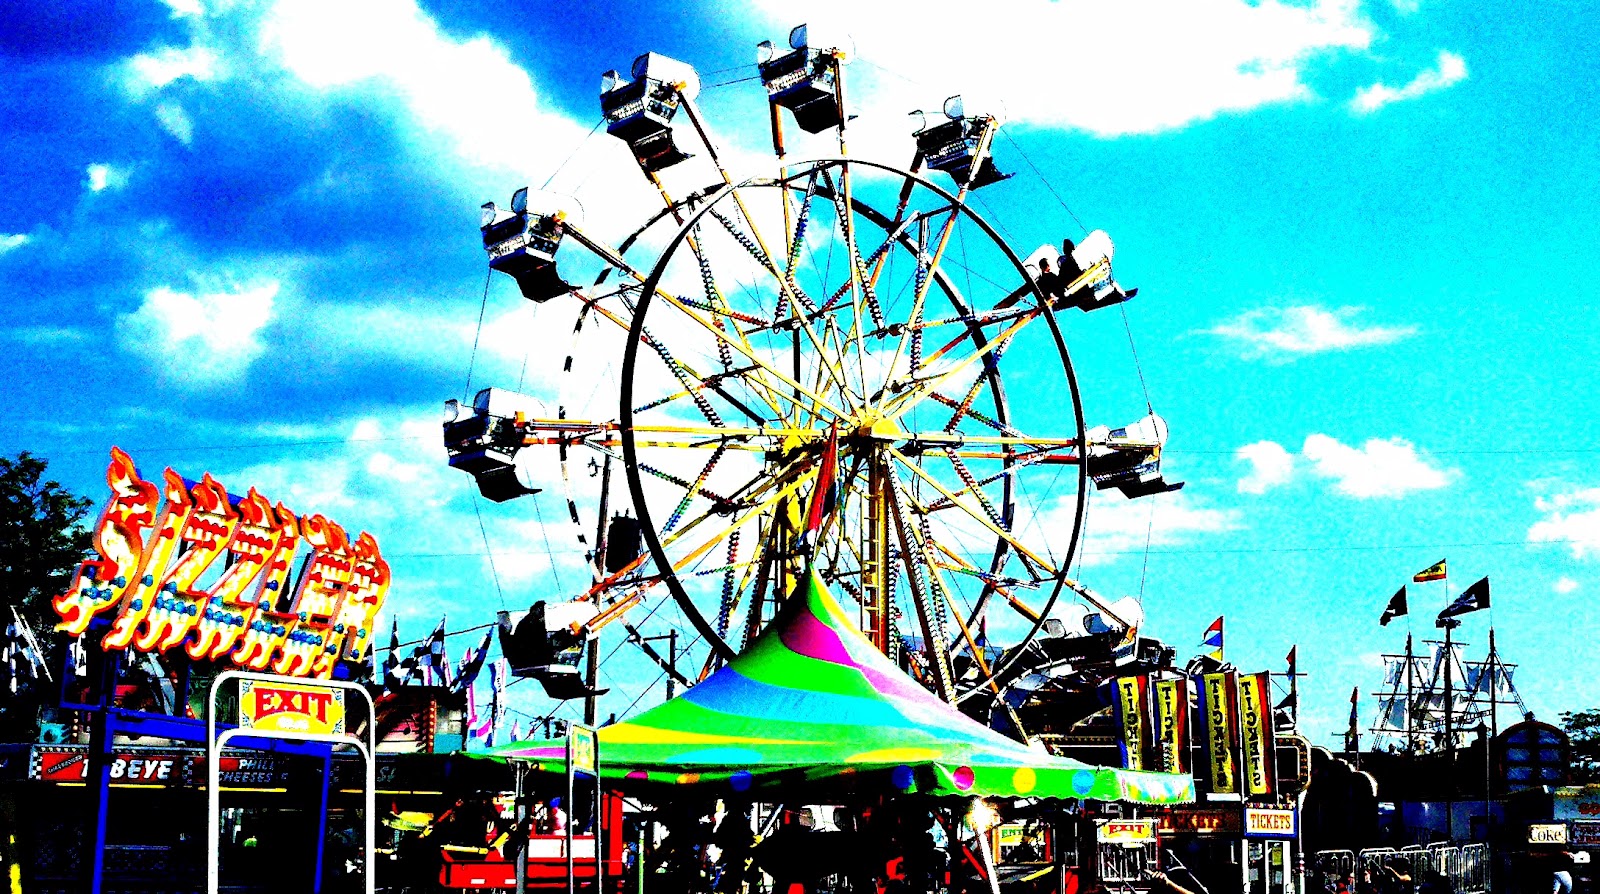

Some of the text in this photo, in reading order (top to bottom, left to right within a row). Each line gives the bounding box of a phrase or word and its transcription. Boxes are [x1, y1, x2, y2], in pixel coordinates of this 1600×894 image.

[52, 445, 392, 680] SIZZLER
[253, 688, 332, 724] EXIT
[1108, 824, 1145, 834] EXIT
[1250, 813, 1291, 829] TICKETS
